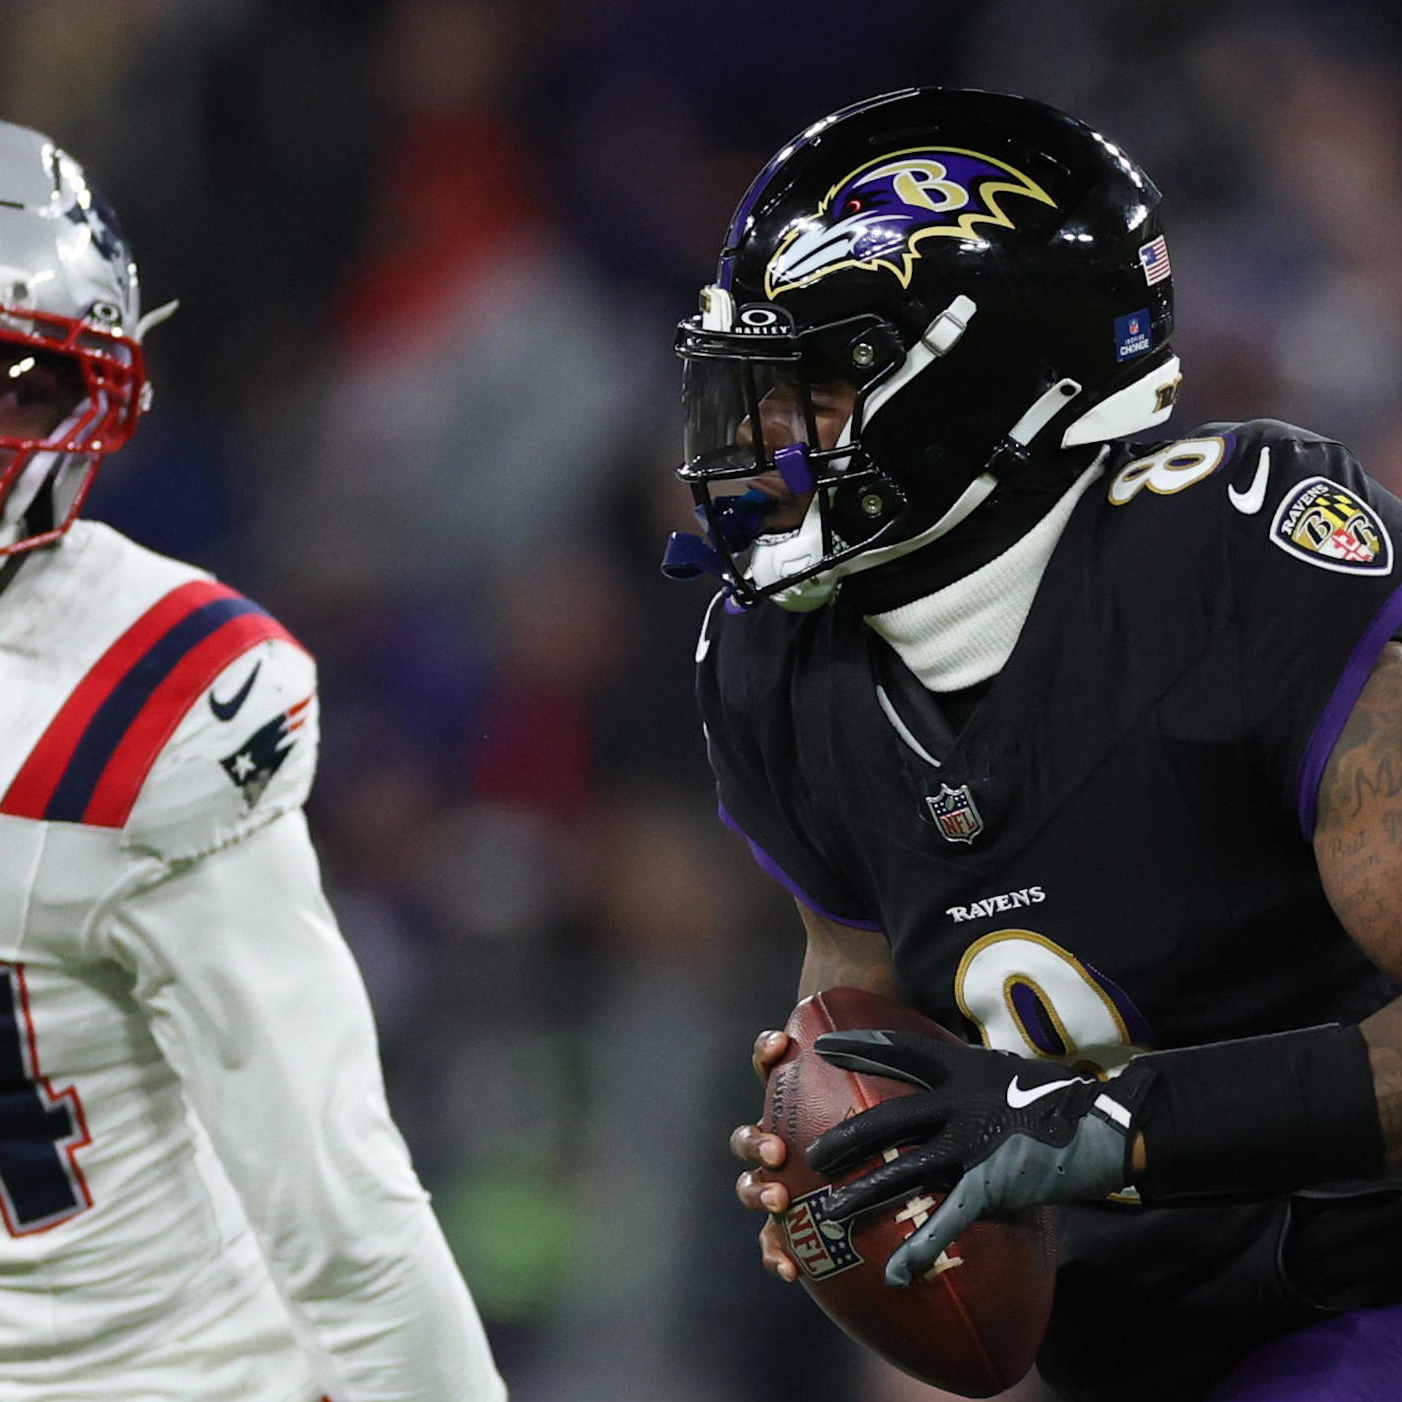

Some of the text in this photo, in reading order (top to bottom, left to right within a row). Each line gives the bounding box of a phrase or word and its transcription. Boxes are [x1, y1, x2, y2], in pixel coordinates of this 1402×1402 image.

[852, 159, 969, 213] B
[1108, 435, 1225, 506] 8
[1281, 484, 1329, 536] RAVENS
[941, 811, 976, 836] NFL
[946, 886, 1047, 923] RAVENS
[787, 1206, 828, 1273] NFL
